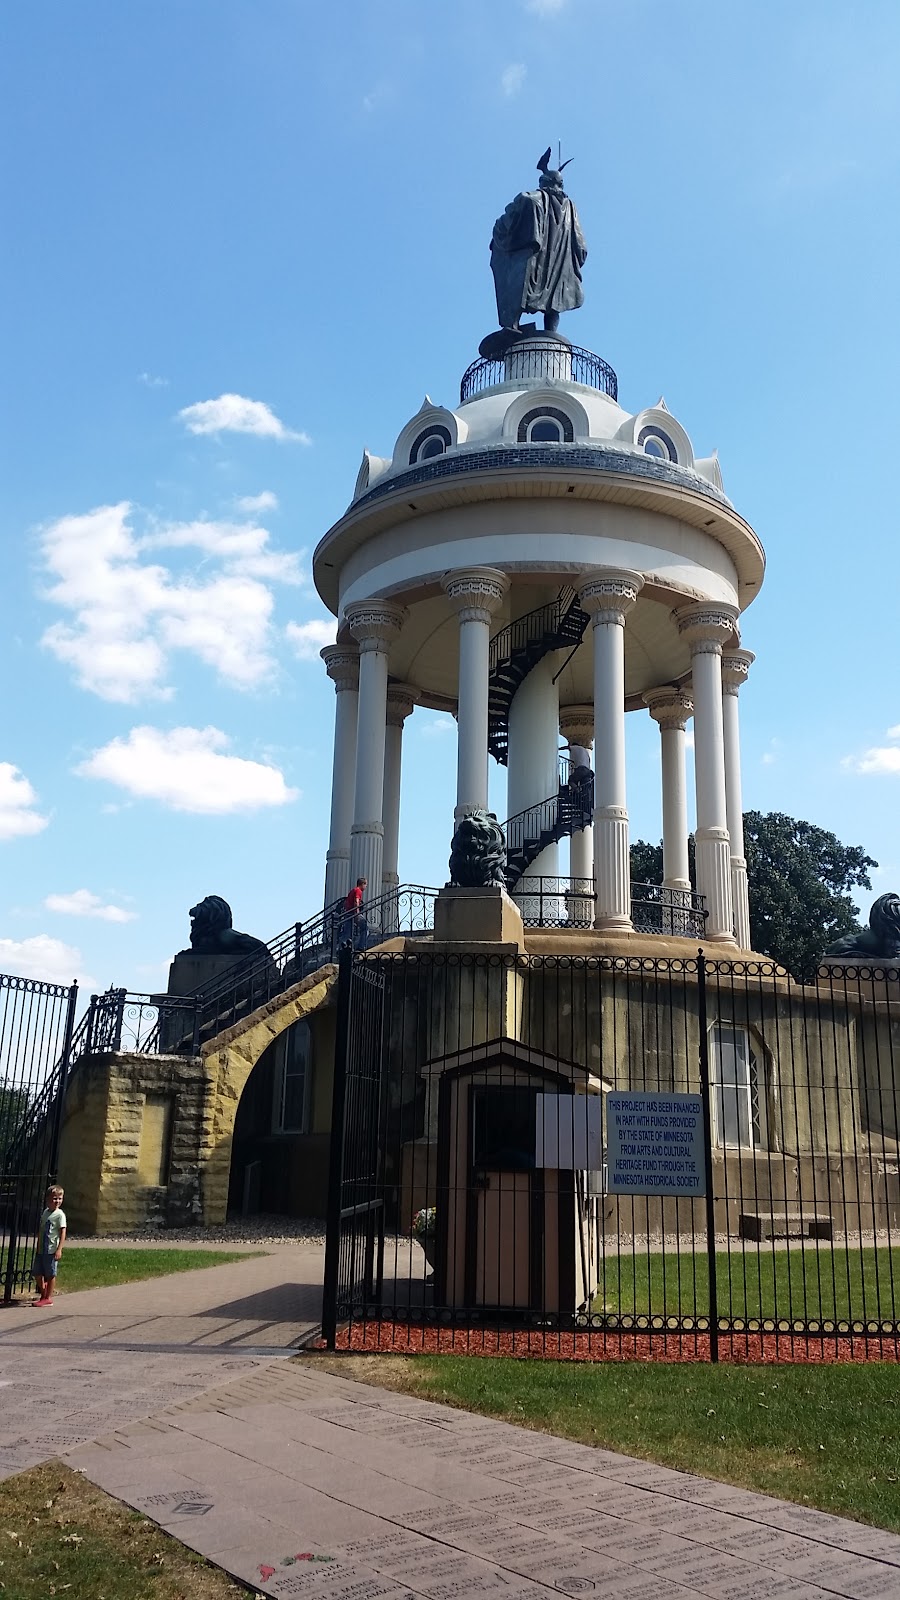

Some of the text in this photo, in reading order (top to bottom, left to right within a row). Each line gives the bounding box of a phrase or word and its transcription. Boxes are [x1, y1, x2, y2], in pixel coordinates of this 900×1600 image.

[609, 1100, 700, 1113] THIS PROJECT HAS BEEN FINANCED
[616, 1116, 696, 1128] IN PART WITH FUNDS PROVIDED
[619, 1130, 694, 1142] BY THE STATE OF MINNESOTA
[621, 1145, 691, 1156] FROM ARTS AND CULTURAL
[616, 1159, 695, 1172] HERITAGE FUND THROUGH THE
[614, 1174, 699, 1187] MINNESOTA HISTORICAL SOCIETY
